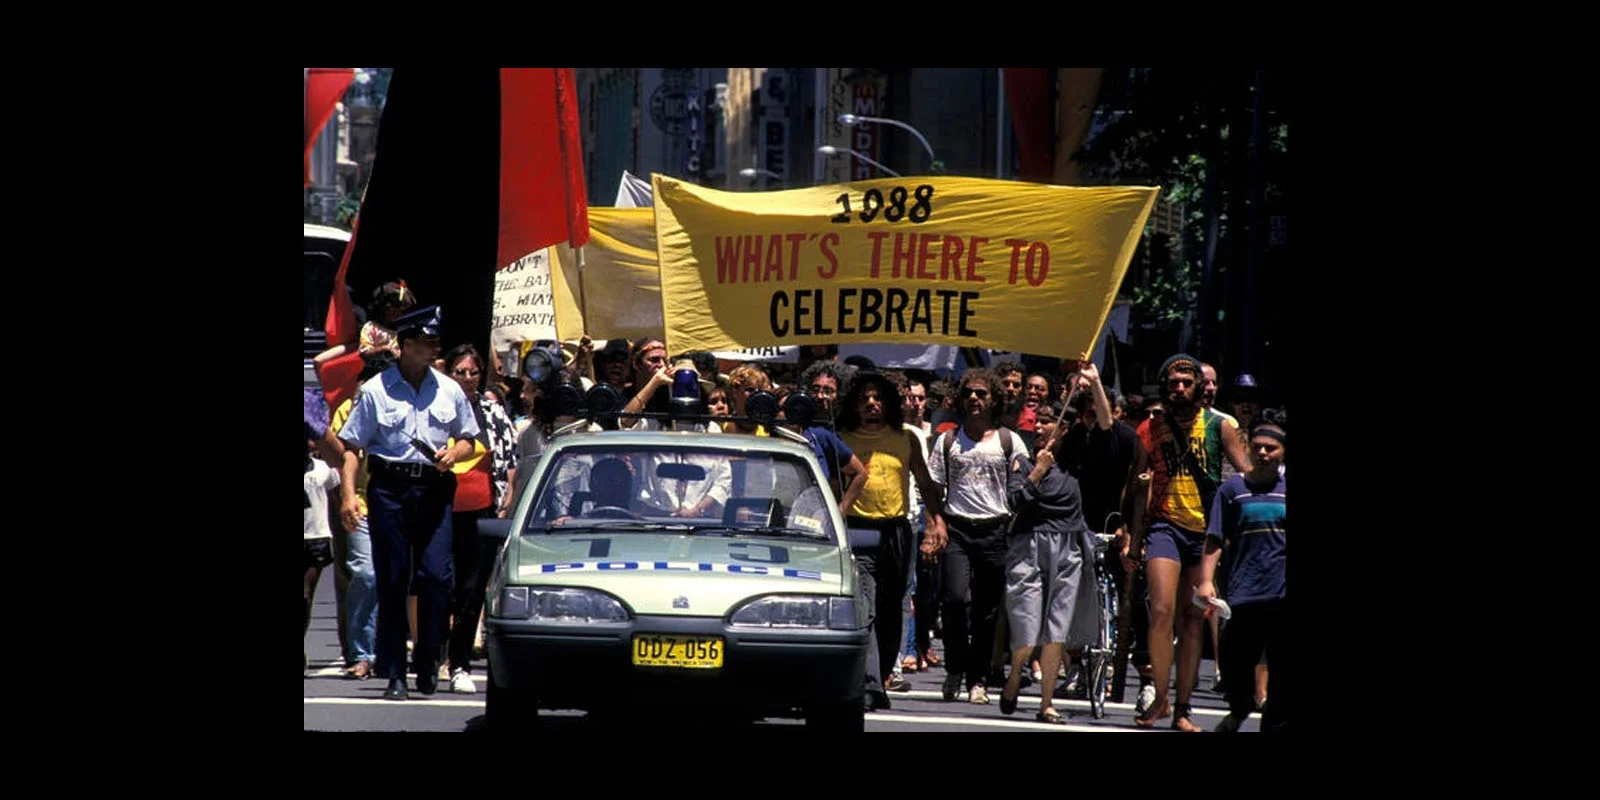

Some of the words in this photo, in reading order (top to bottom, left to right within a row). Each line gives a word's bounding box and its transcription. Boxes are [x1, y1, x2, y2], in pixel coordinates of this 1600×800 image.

[831, 184, 935, 224] 1988
[500, 254, 542, 274] ON'T
[714, 231, 840, 284] WHAT'S
[867, 231, 991, 283] THERE
[1004, 238, 1050, 288] TO
[769, 287, 980, 338] CELEBRATE
[541, 561, 822, 581] POLICE
